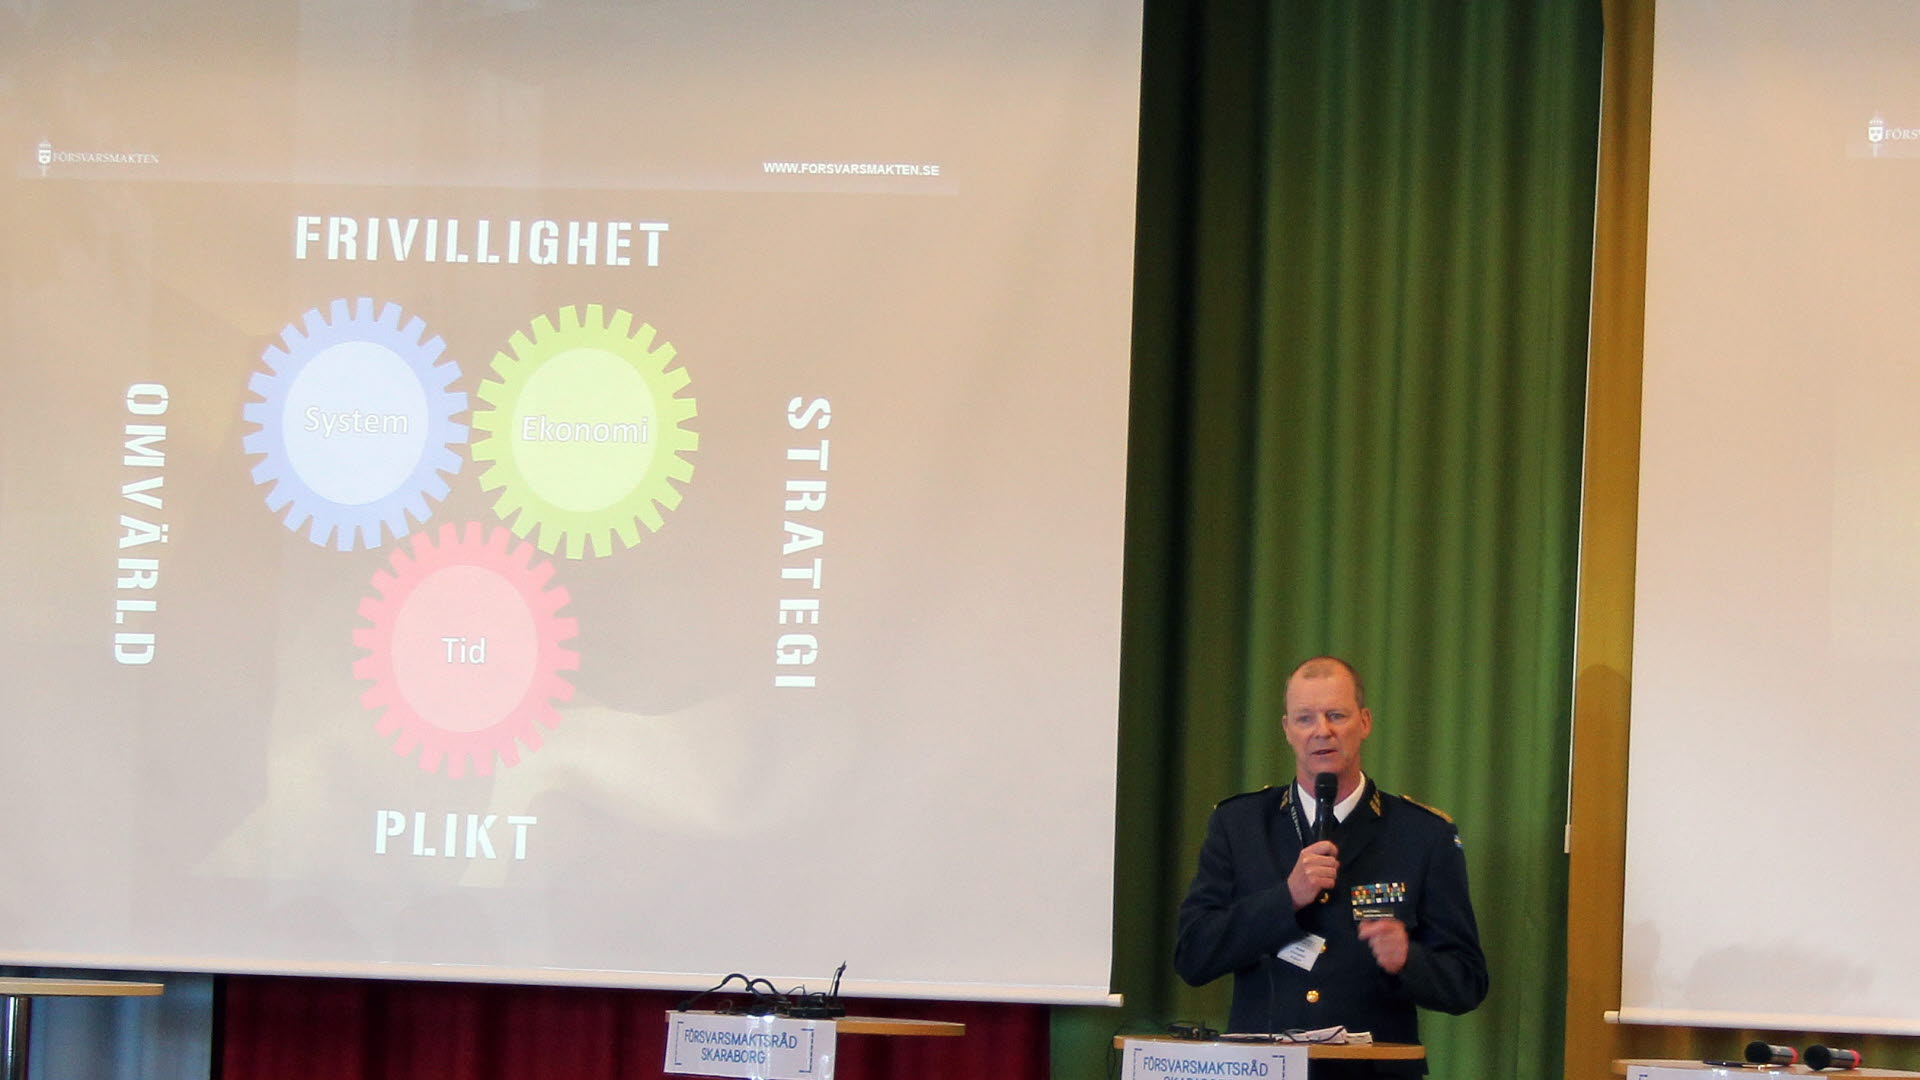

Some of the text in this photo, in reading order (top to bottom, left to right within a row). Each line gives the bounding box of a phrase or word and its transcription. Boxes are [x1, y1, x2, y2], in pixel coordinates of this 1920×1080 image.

[1885, 127, 1920, 140] FÖRS
[763, 162, 940, 176] WWW.FORSVARSMAKTEN.SE
[296, 215, 670, 266] FRIVILLIGHET
[304, 405, 409, 438] System
[522, 415, 649, 444] Ekonomi
[114, 383, 169, 665] OMVÄRLD
[775, 396, 832, 687] STRATEGI
[441, 636, 487, 665] Tid
[375, 810, 538, 860] PLIKT
[684, 1028, 798, 1049] FÖRSVARSMAKTSRÅD
[701, 1047, 766, 1065] SKARABORG
[1143, 1056, 1269, 1077] FÖRSVARSMAKTSRÅD
